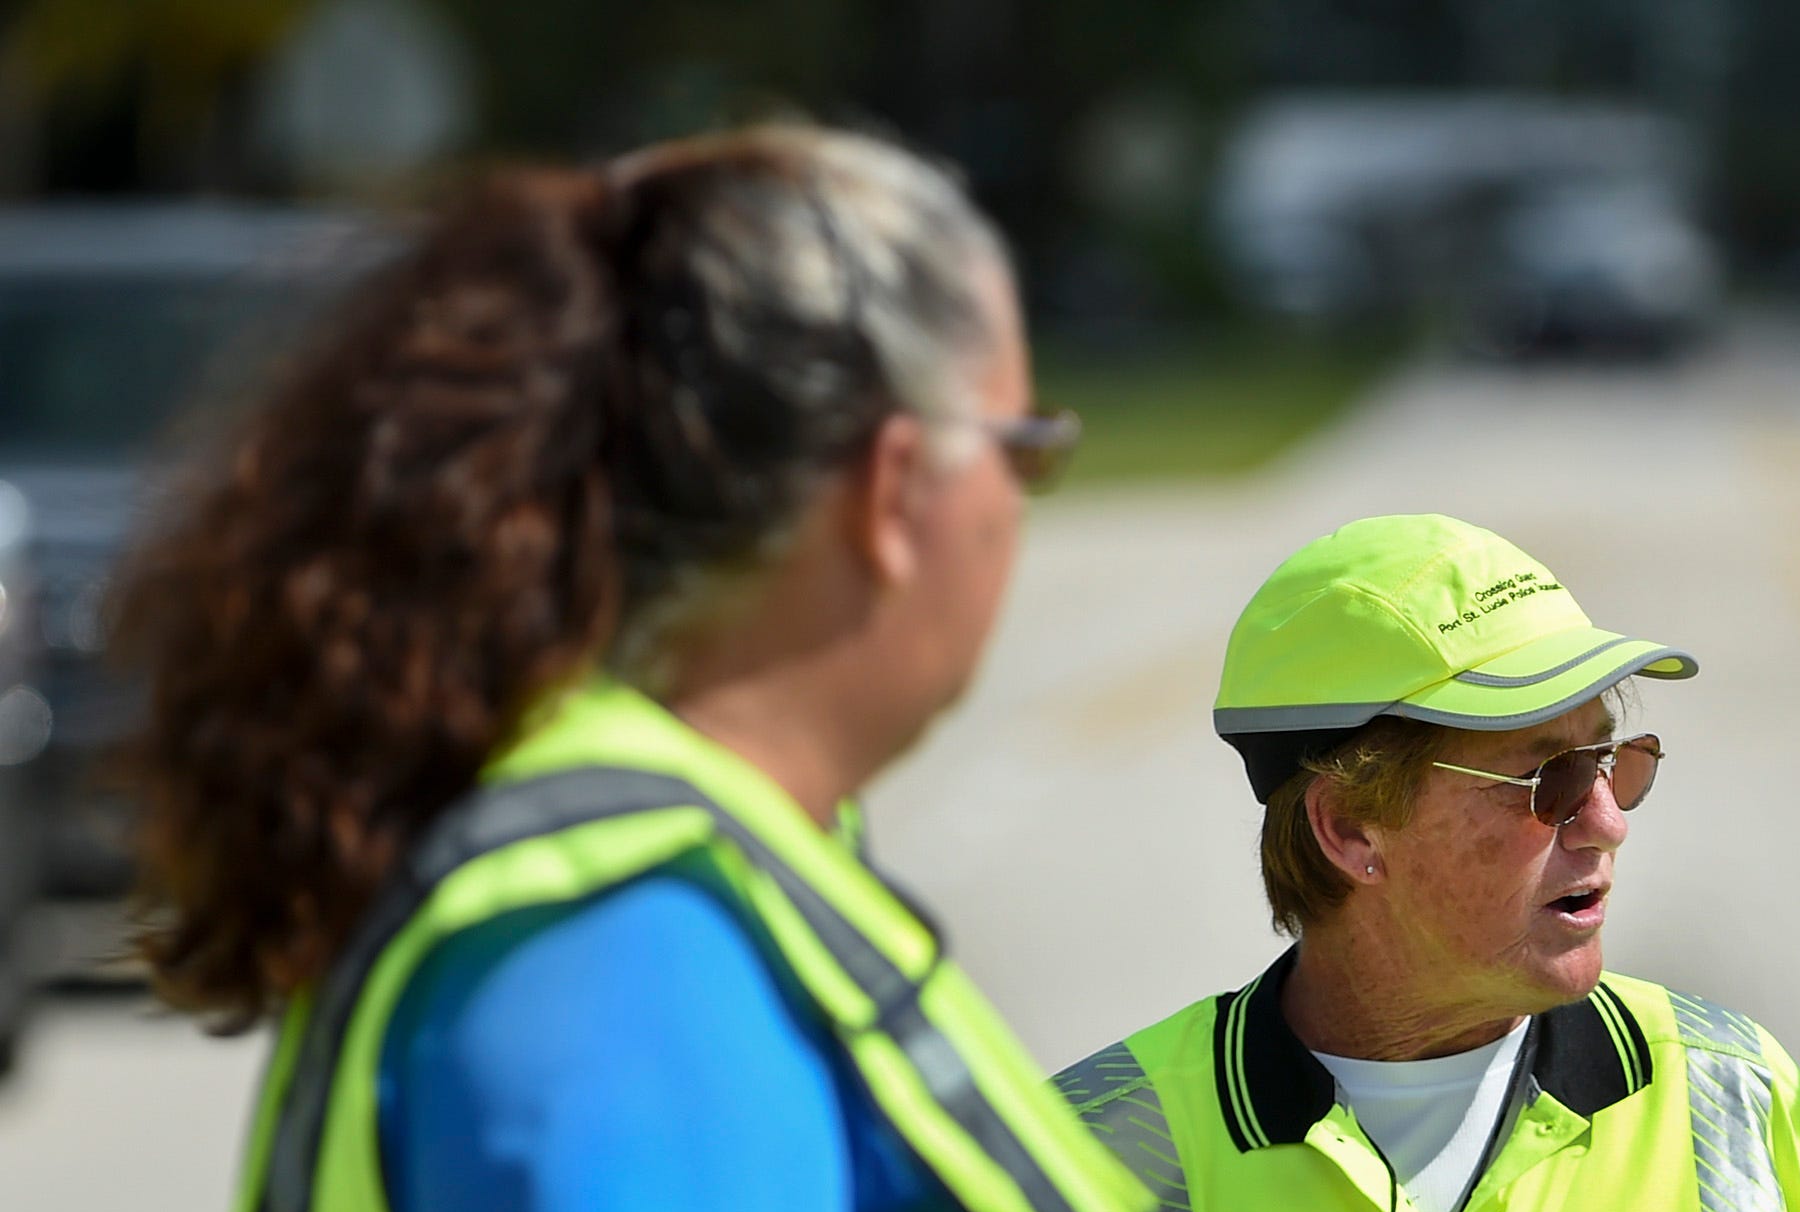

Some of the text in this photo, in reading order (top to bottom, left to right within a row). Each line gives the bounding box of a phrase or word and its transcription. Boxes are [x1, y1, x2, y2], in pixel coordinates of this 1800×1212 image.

[1475, 579, 1516, 601] Crossing
[1438, 619, 1462, 634] Port
[1480, 597, 1509, 614] Lucie
[1509, 587, 1536, 600] Police
